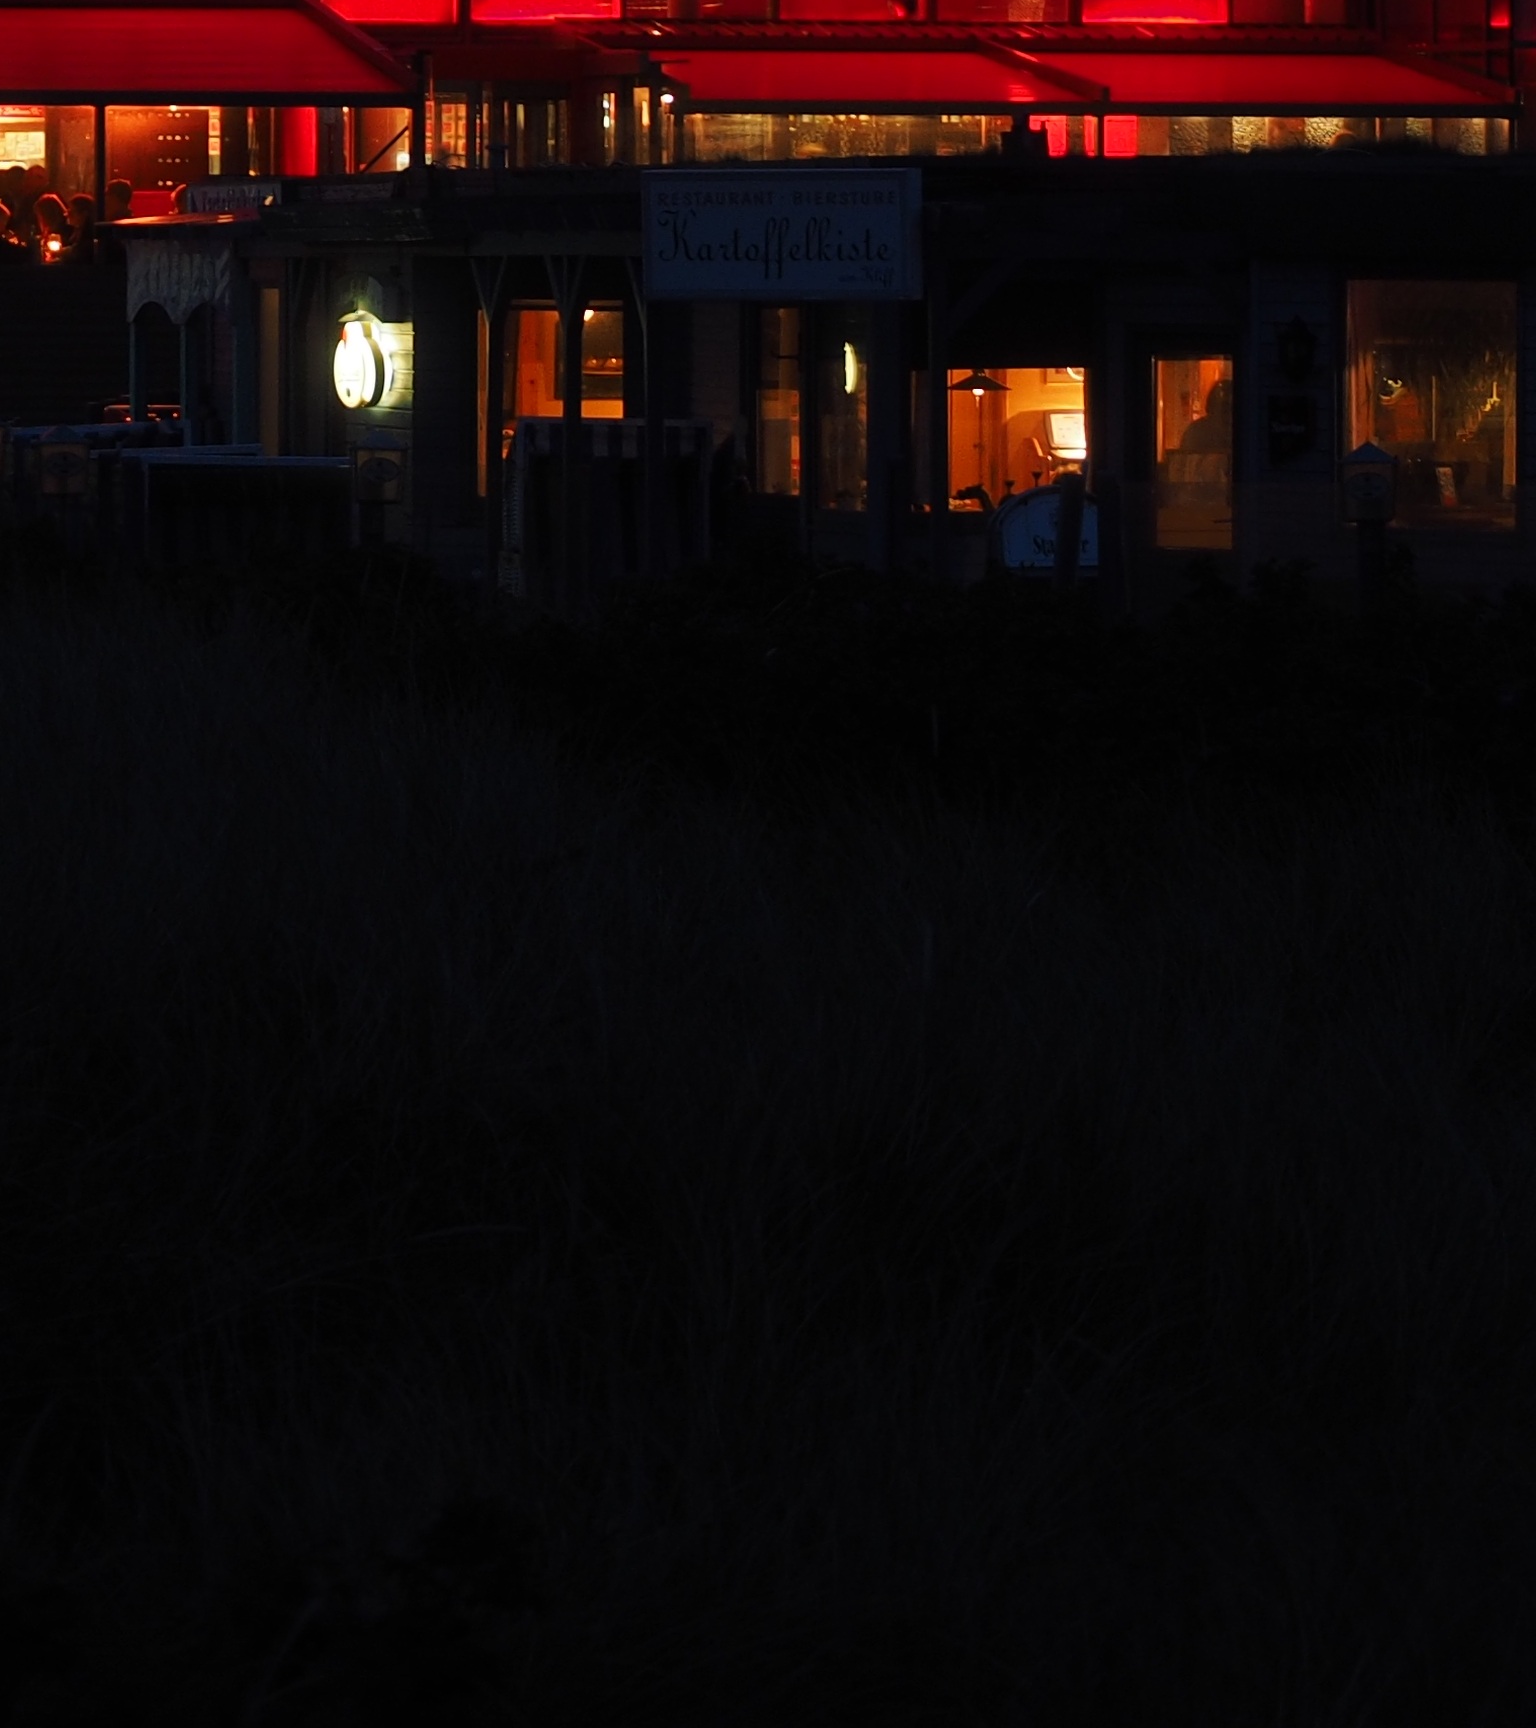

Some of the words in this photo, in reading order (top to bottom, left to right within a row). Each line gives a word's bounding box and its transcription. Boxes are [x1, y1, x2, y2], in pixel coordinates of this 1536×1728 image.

[657, 190, 775, 207] RESTAURANT
[792, 189, 897, 206] BIERSTUBE
[657, 209, 892, 280] Kartoffelkiste
